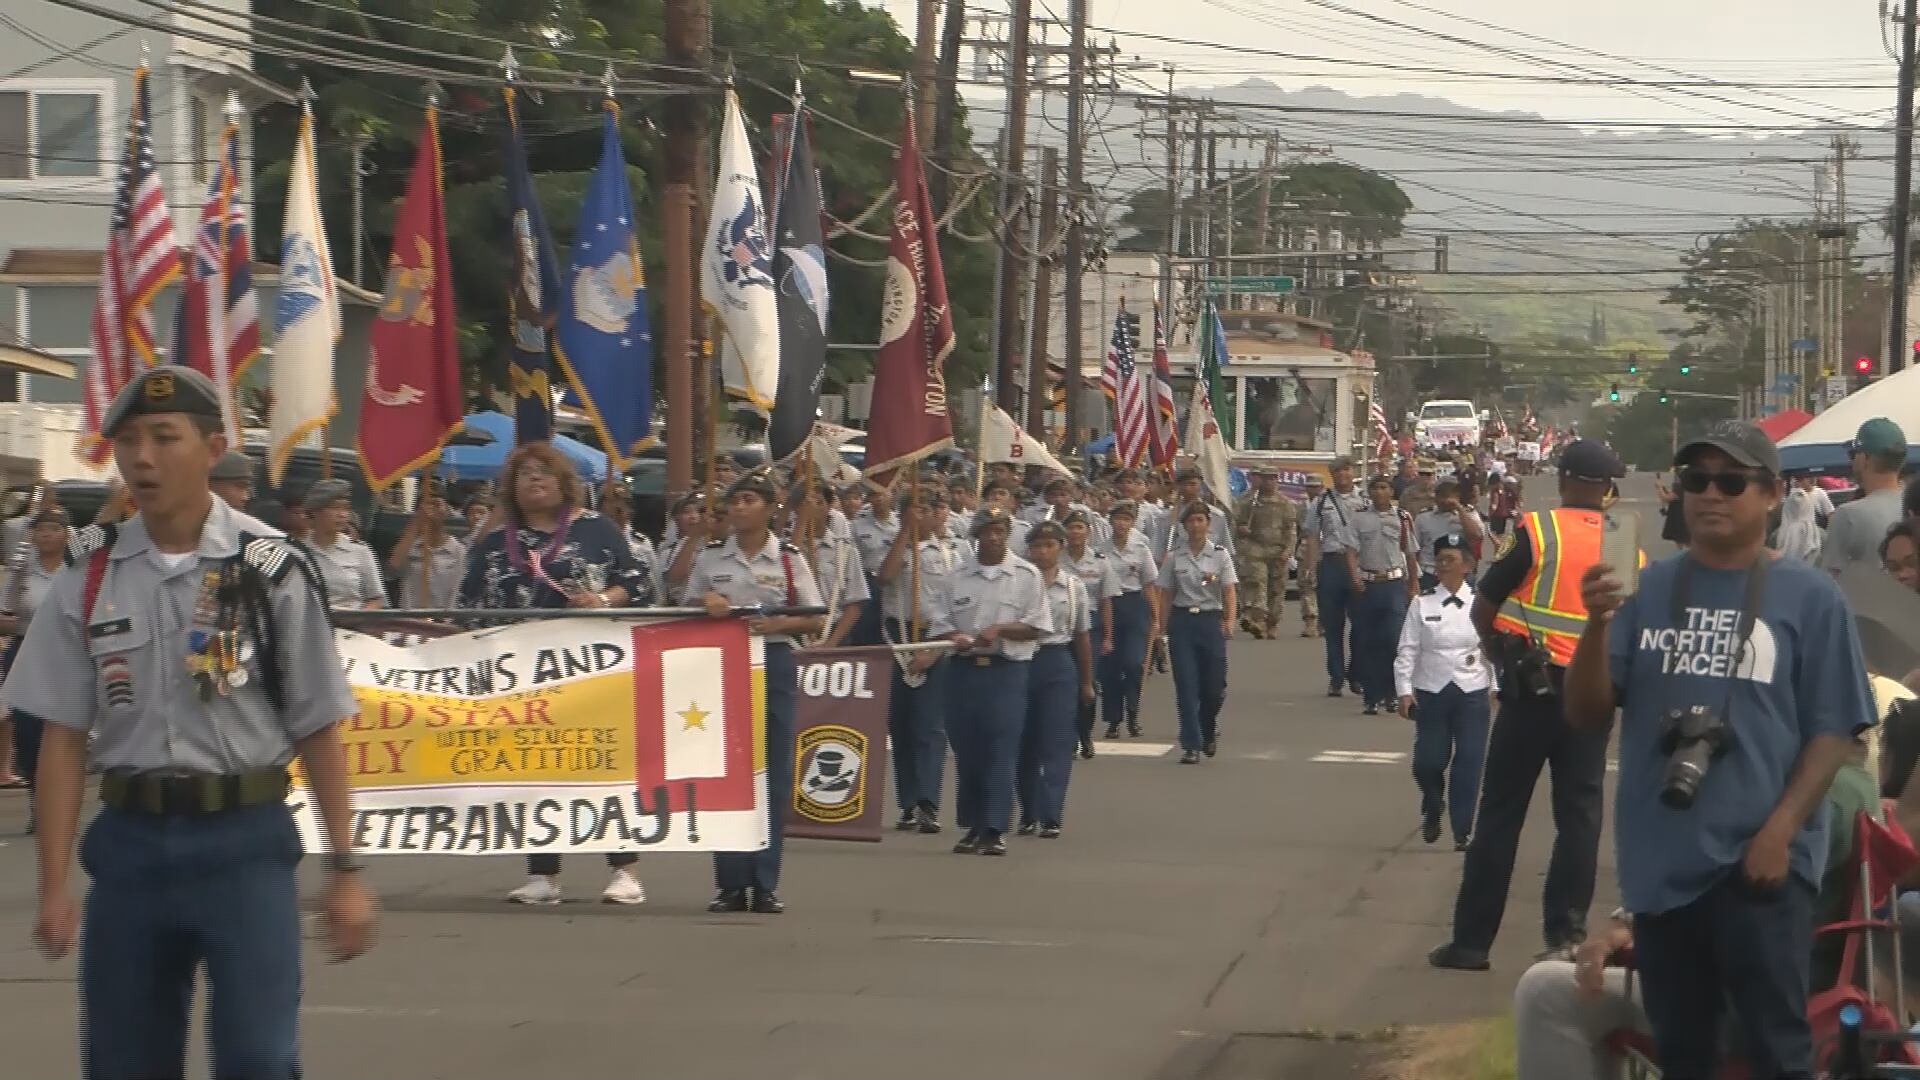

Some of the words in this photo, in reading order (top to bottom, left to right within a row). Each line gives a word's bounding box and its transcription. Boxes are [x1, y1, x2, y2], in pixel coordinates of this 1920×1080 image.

[1685, 607, 1736, 632] THE
[1639, 628, 1731, 654] NORTH
[532, 642, 626, 684] AND
[345, 699, 416, 732] LD
[426, 698, 557, 728] STAR
[436, 728, 499, 748] WITH
[514, 727, 619, 746] SINCERE
[342, 739, 413, 776] ILY
[450, 746, 619, 775] GRATITUDE
[352, 798, 563, 852] ETERANS
